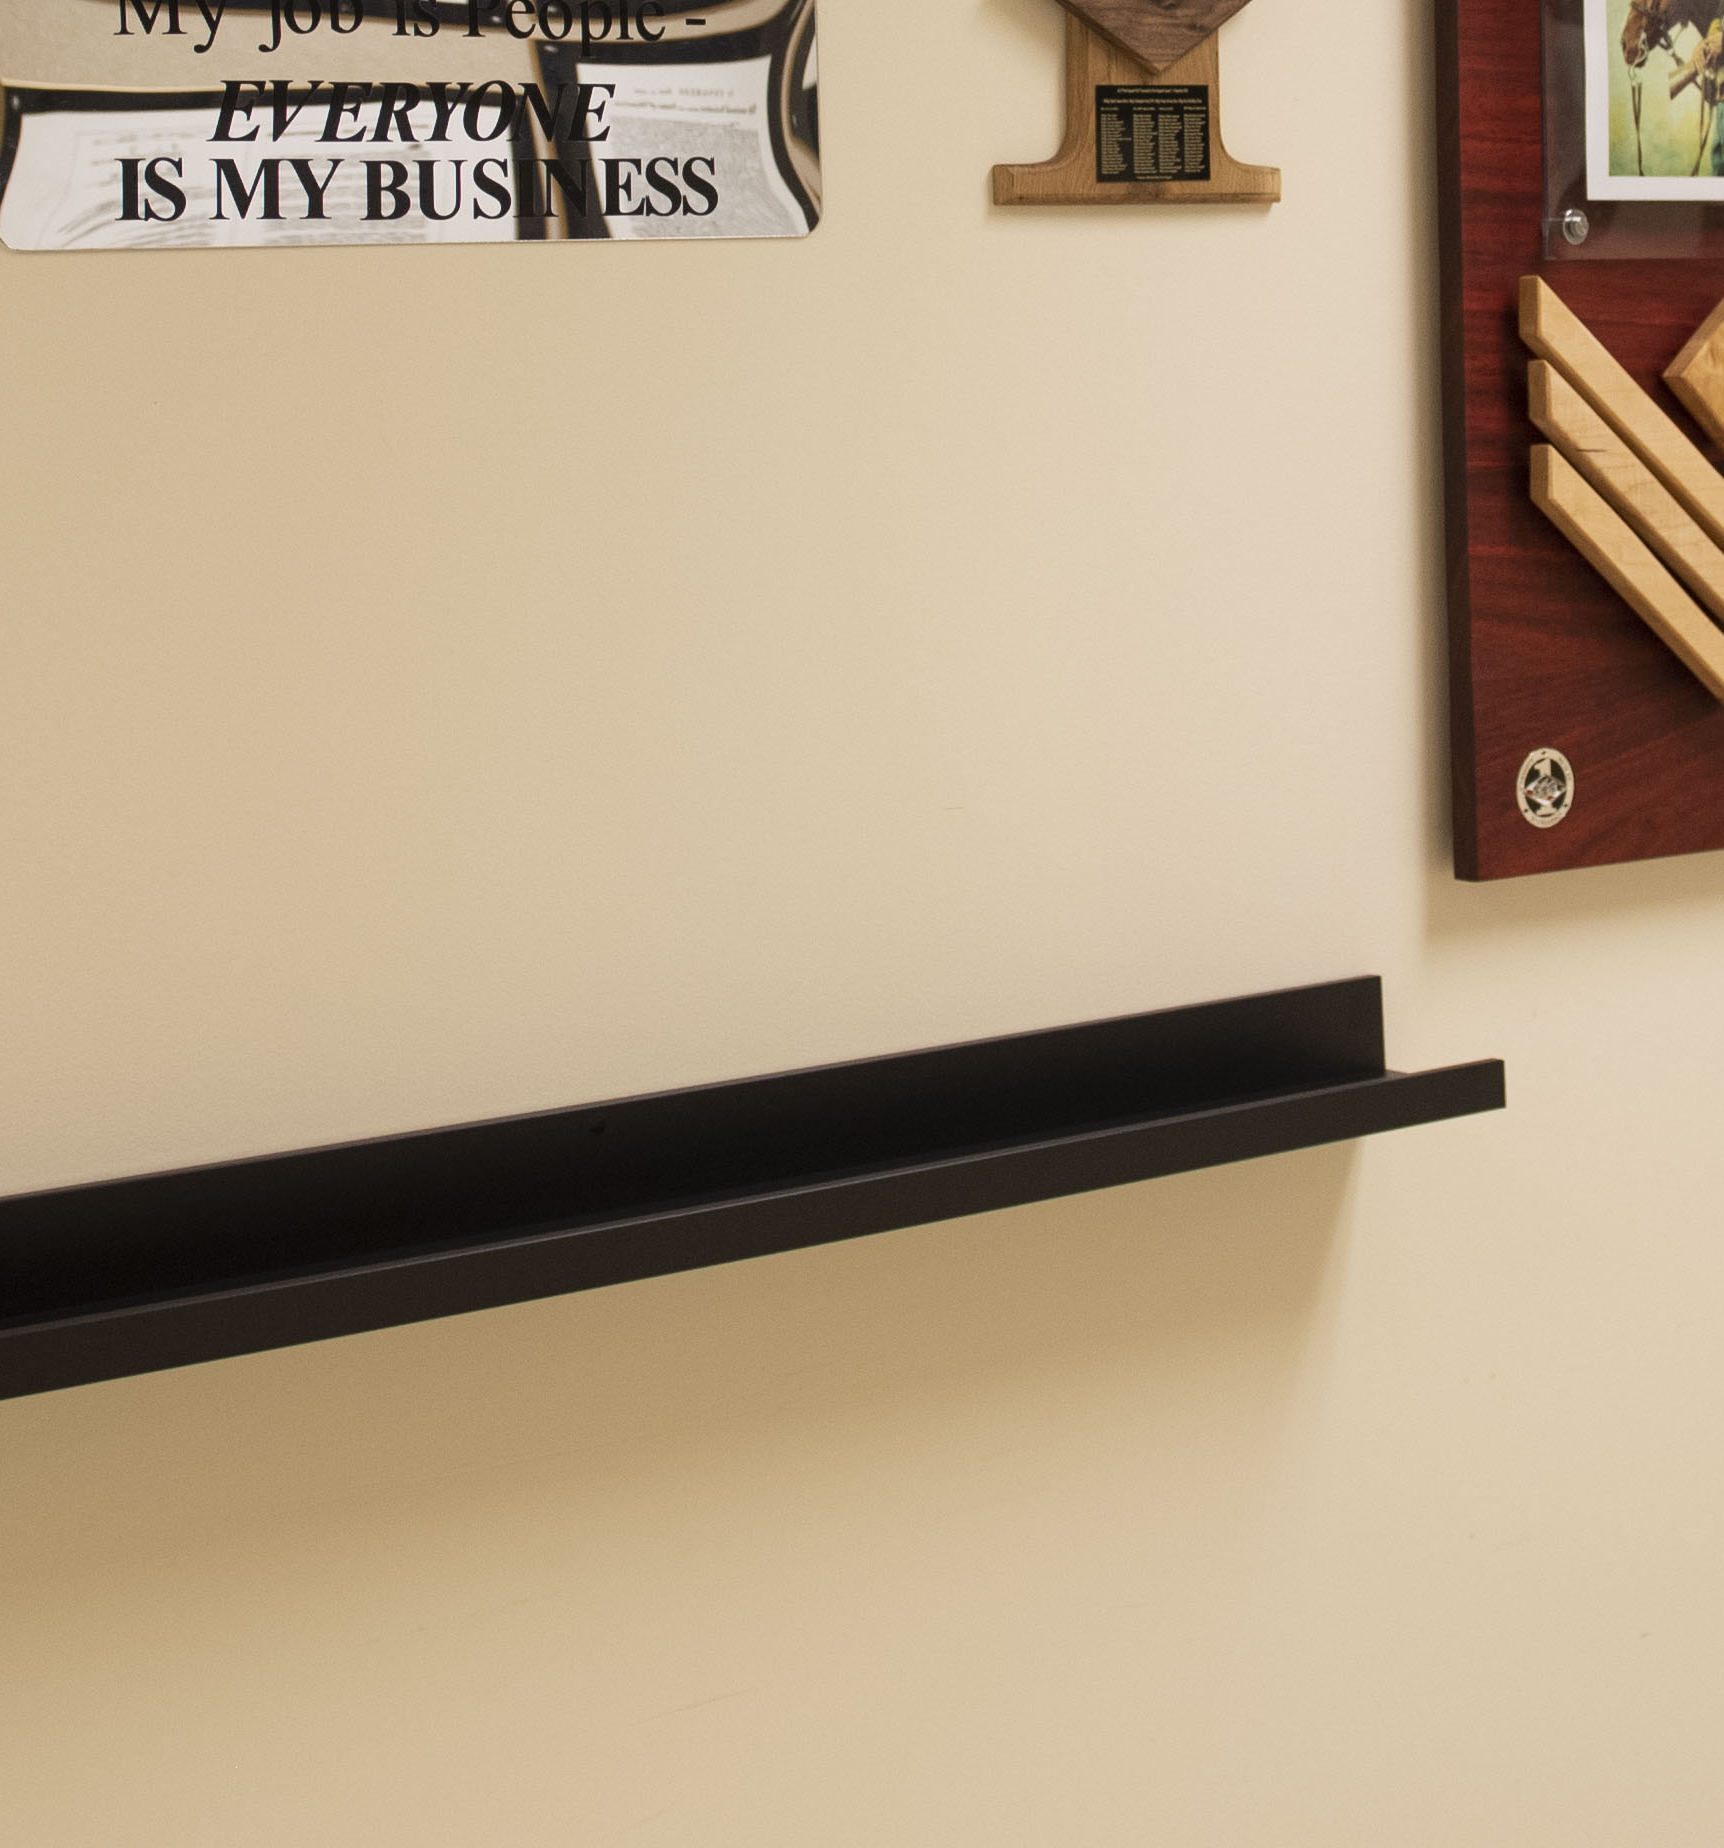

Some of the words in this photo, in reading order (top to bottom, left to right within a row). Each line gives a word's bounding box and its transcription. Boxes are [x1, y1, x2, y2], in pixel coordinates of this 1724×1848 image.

[206, 79, 615, 144] EVERYONE
[114, 156, 186, 224] IS
[212, 156, 343, 222] MY
[360, 154, 719, 223] BUSINESS
